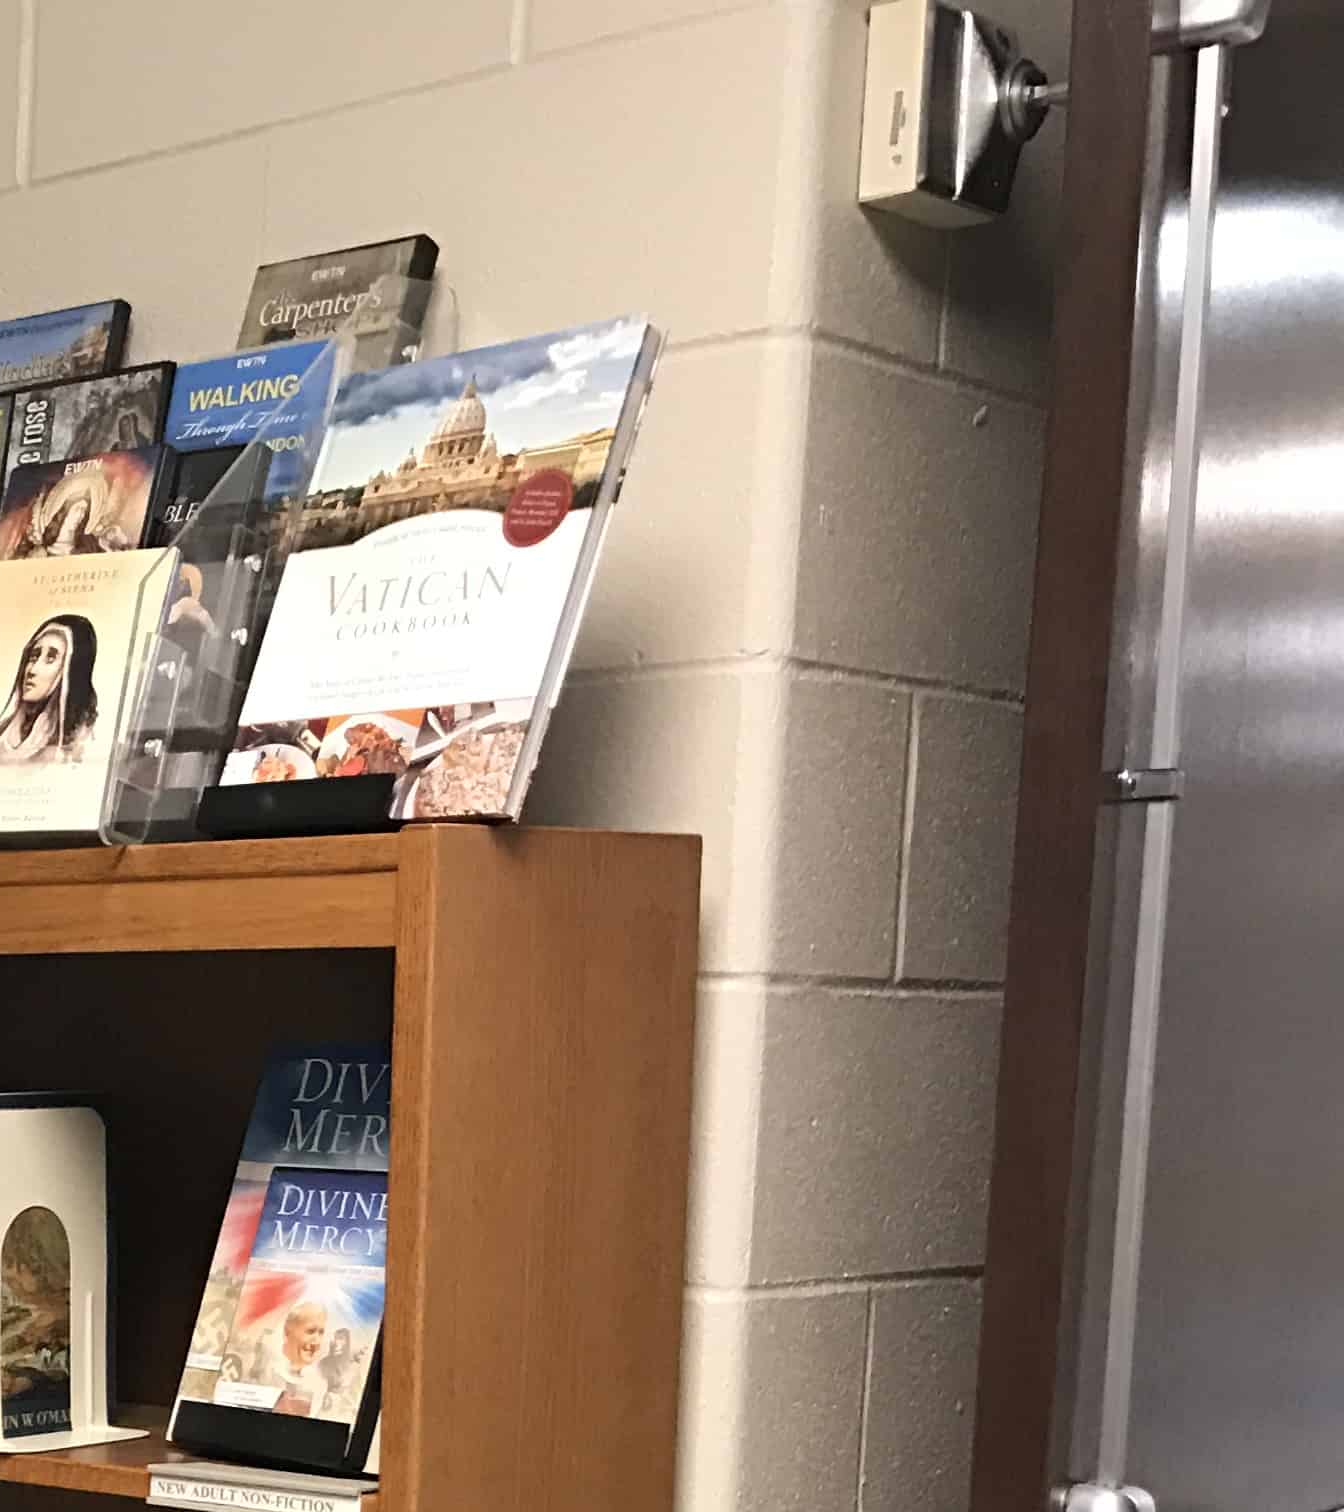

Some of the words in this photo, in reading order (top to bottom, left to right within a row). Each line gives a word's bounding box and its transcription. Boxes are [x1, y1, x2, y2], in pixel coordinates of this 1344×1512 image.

[259, 292, 382, 330] Carpenter's
[189, 374, 300, 412] WALKING
[176, 414, 247, 445] Through
[64, 459, 104, 475] EWTN
[329, 562, 512, 617] VATICAN
[336, 611, 472, 641] COOKBOOK
[296, 1058, 390, 1104] DIV
[282, 1109, 389, 1155] MER
[270, 1221, 384, 1256] MERCY
[157, 1480, 186, 1495] NEW
[190, 1484, 236, 1502] ADULT
